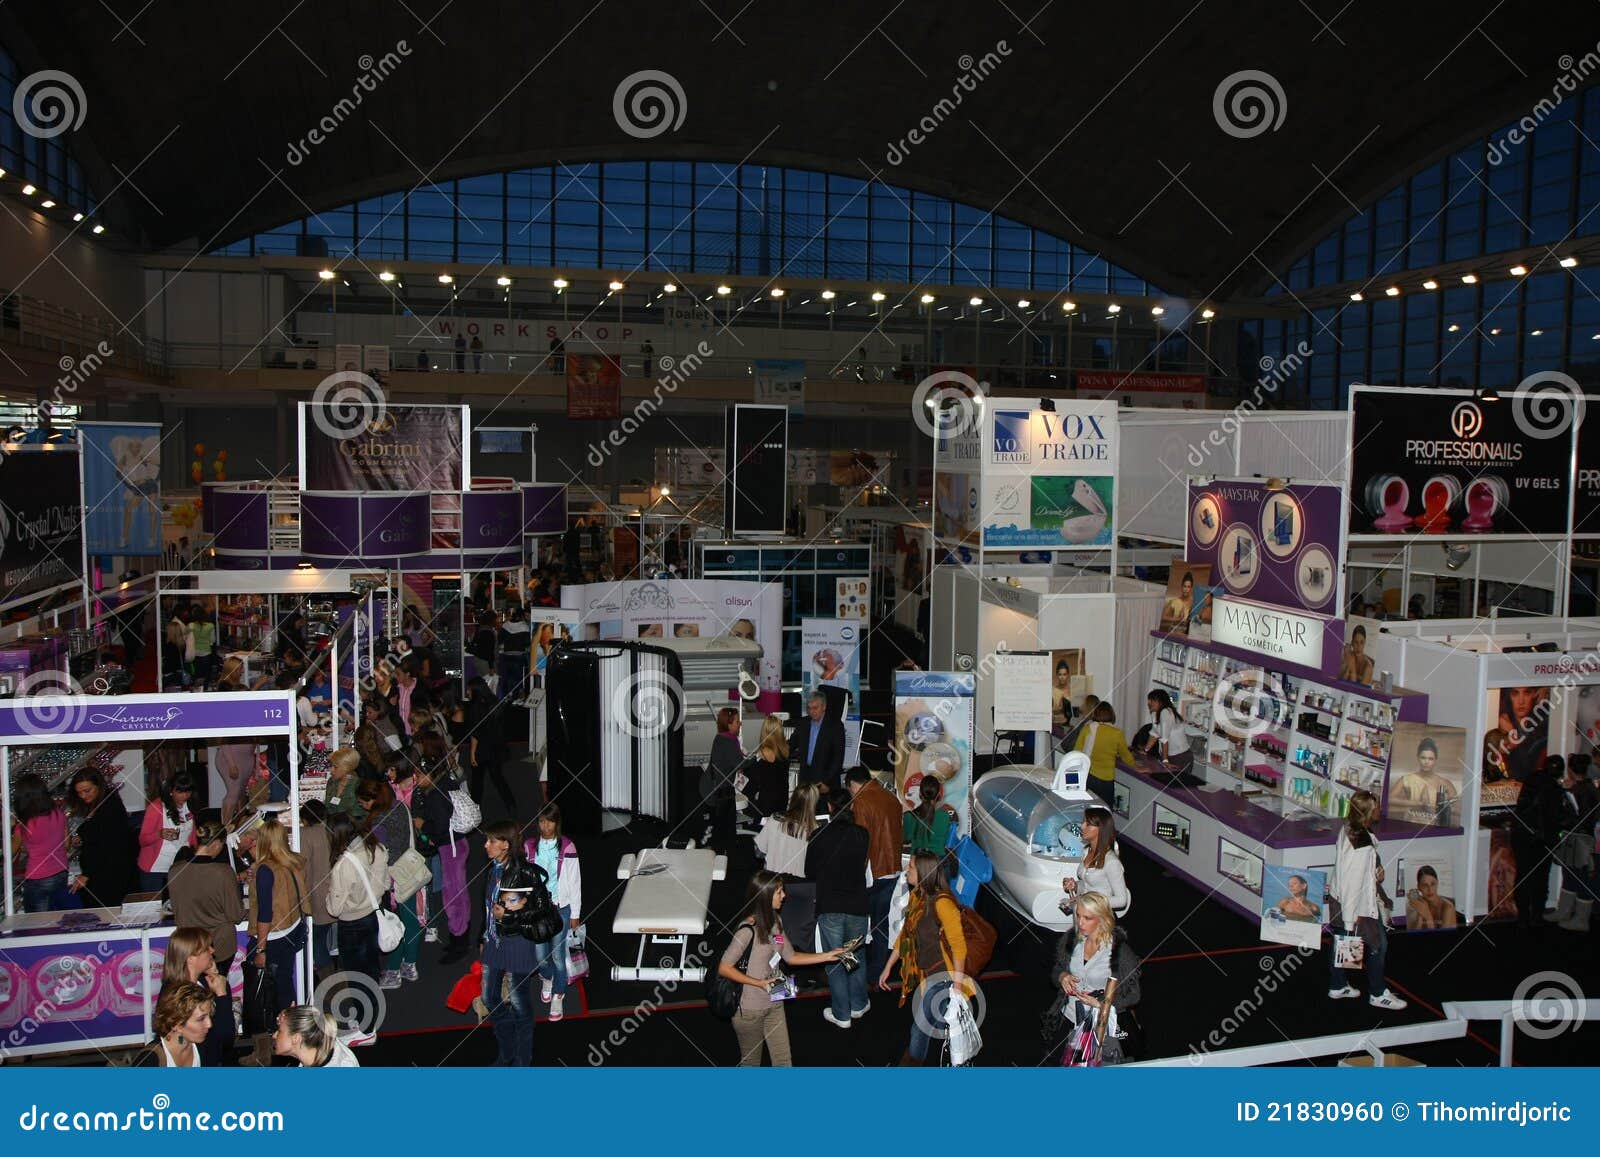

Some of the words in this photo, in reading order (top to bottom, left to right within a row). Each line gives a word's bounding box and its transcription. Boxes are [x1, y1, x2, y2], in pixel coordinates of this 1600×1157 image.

[438, 321, 633, 340] WORKSHOP
[1040, 414, 1106, 440] VOX
[995, 452, 1029, 462] TRADE
[1039, 443, 1108, 461] TRADE
[1405, 440, 1523, 461] PROFESSIONAILS
[1515, 477, 1530, 488] UV
[1532, 477, 1560, 489] GELS
[1216, 487, 1260, 502] MAYSTAR
[725, 596, 753, 607] alisun
[1223, 606, 1306, 647] MAYSTAR
[90, 706, 183, 728] Harmony
[263, 708, 282, 719] 112
[121, 722, 160, 730] CRYSTAL
